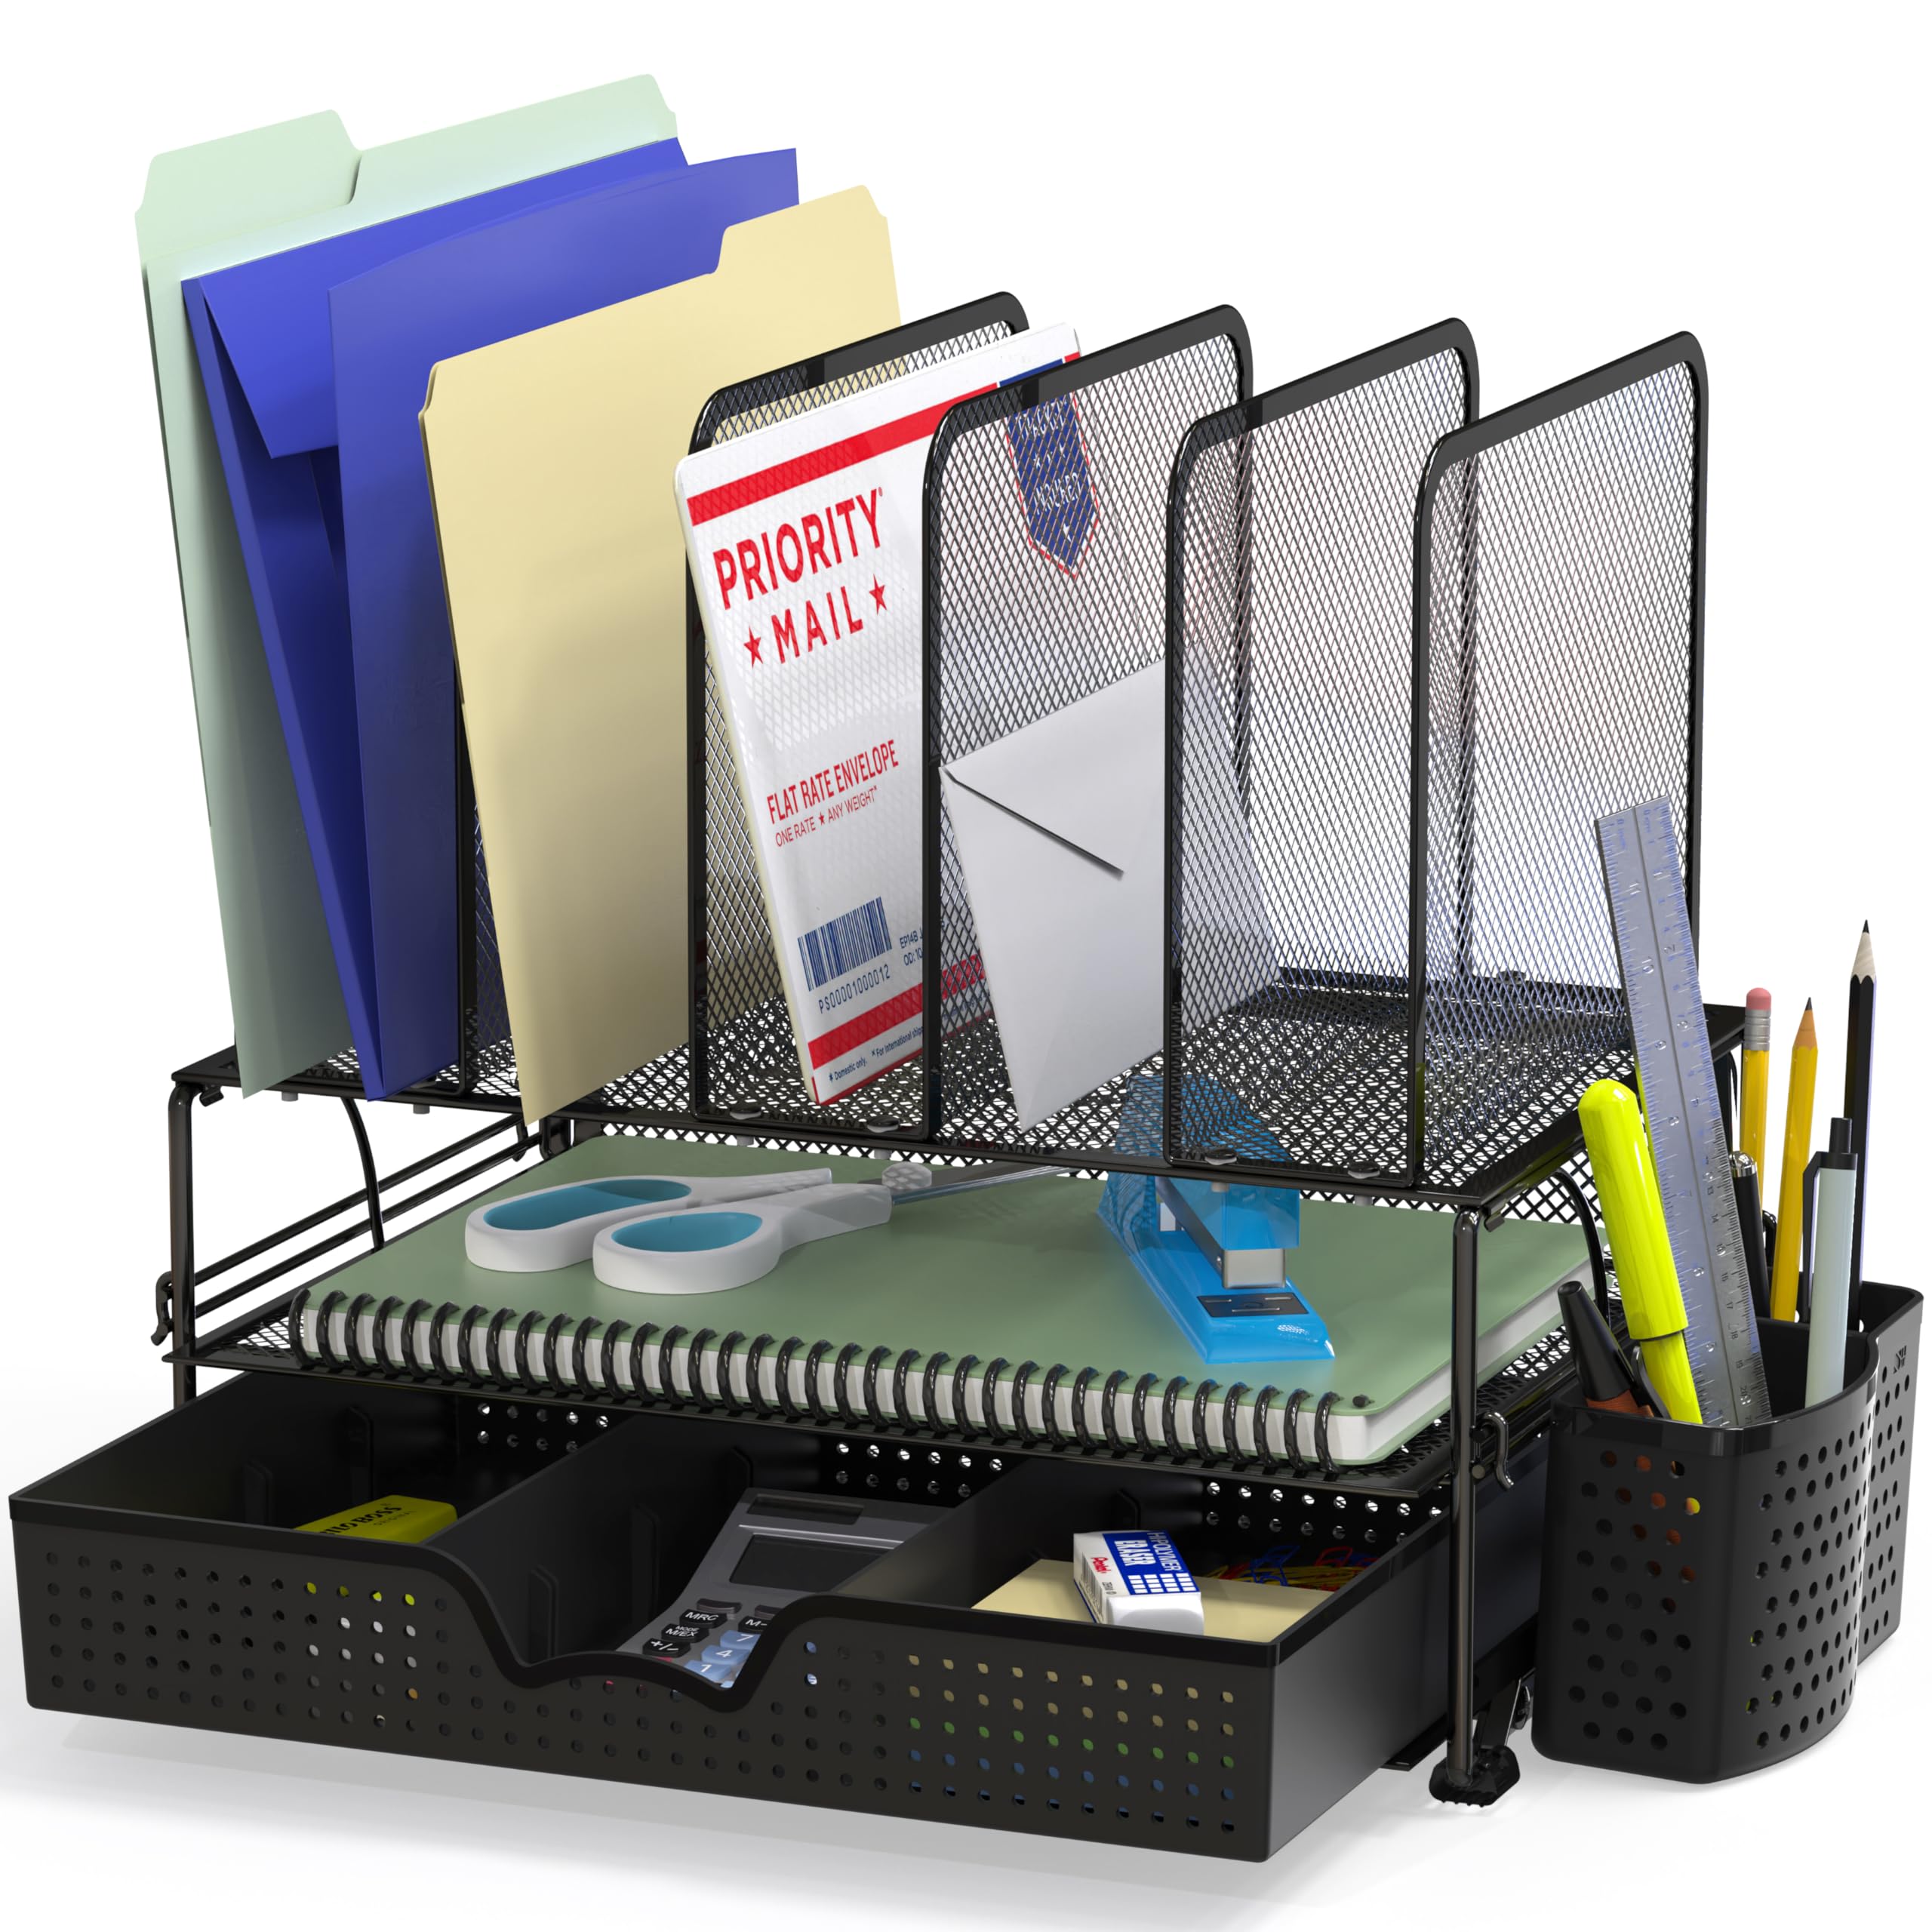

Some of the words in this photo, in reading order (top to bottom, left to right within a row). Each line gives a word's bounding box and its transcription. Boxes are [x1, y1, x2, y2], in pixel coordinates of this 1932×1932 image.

[771, 586, 863, 664] MAIL
[767, 785, 798, 825] FLAT
[800, 769, 835, 809] RATE
[833, 739, 899, 792] ENVELOPE
[775, 827, 794, 848] ONE
[794, 817, 816, 839] RATE
[828, 802, 844, 823] ANY
[900, 930, 918, 949] EP14B
[903, 952, 916, 966] OD:
[818, 963, 891, 1014] PS00001000012
[834, 1063, 856, 1081] Domestic
[352, 1506, 402, 1524] BOSS
[1114, 1540, 1156, 1566] ERASER
[685, 1611, 719, 1621] MRC
[665, 1628, 699, 1637] M/EX
[737, 1633, 755, 1642] 7
[715, 1649, 733, 1658] 4
[701, 1663, 712, 1673] 1
